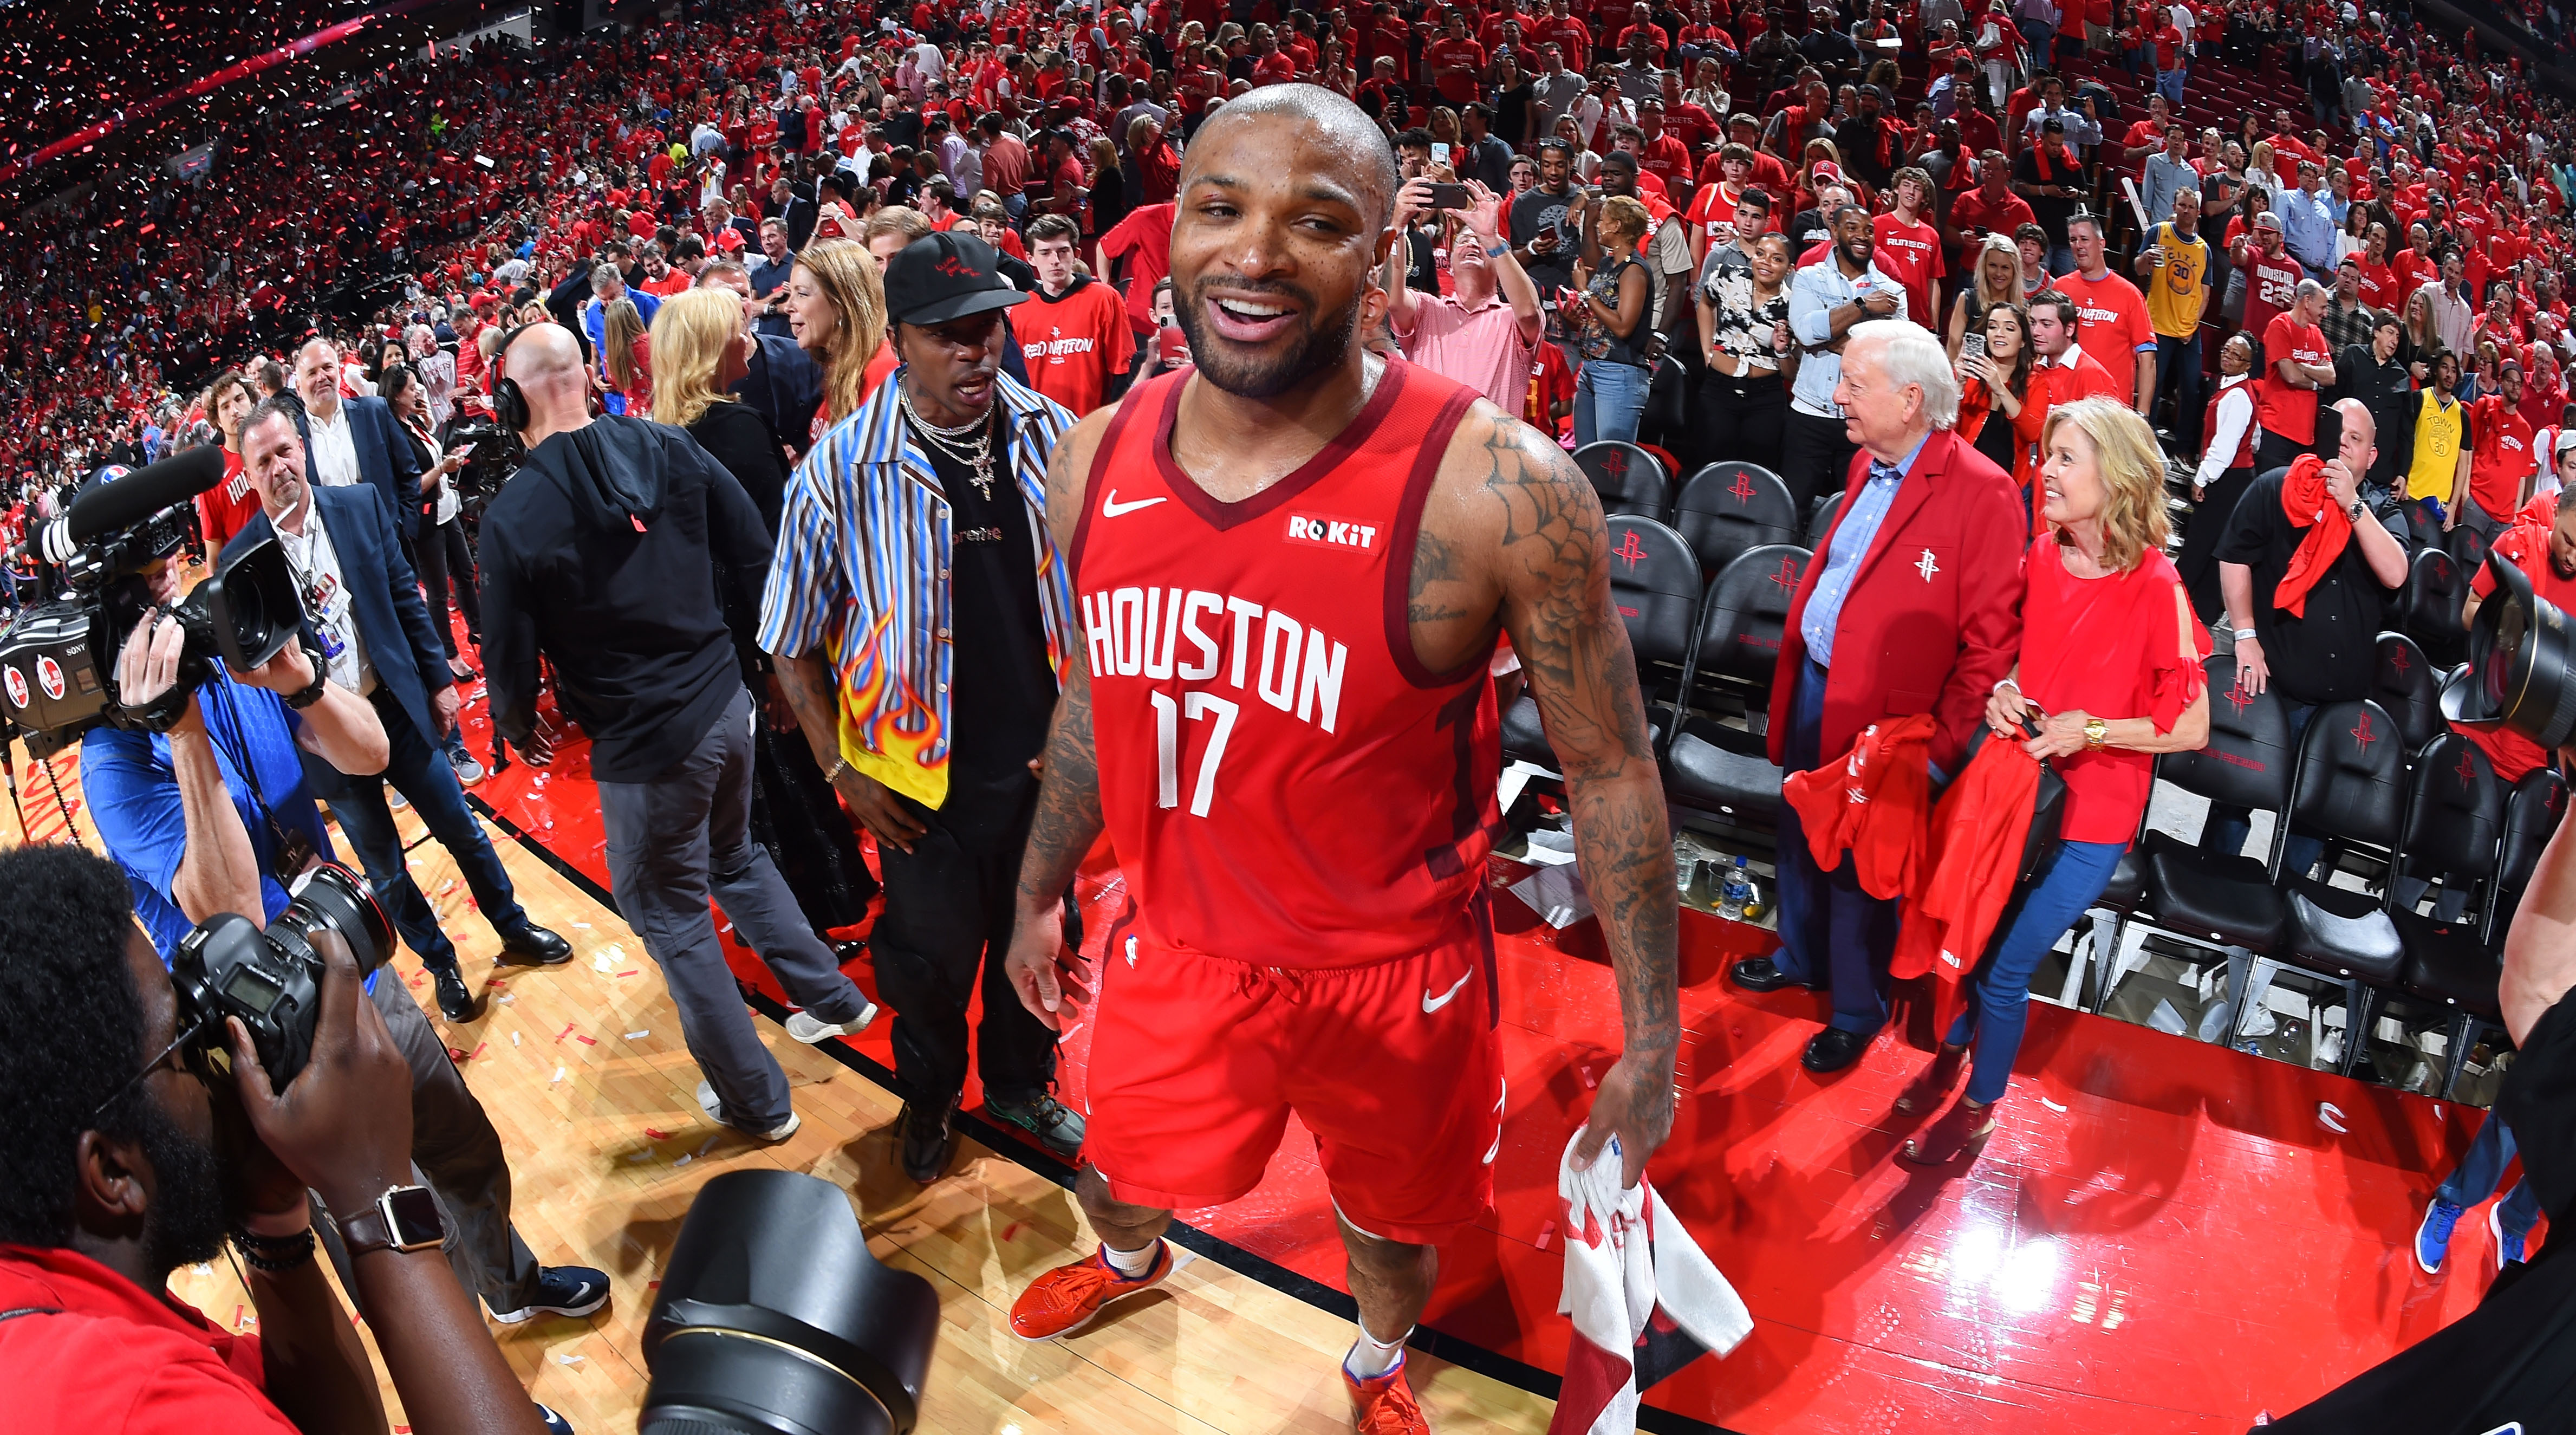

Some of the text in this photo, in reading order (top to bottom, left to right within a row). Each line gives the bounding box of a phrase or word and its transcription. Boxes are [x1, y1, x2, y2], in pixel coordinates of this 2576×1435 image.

[1887, 238, 1909, 246] RUN
[1916, 241, 1933, 252] ONE
[2167, 251, 2197, 268] CITY
[2173, 263, 2190, 280] 30
[2259, 280, 2287, 309] 22
[2081, 308, 2119, 323] NATION
[1022, 337, 1095, 360] RED NATION
[2427, 415, 2455, 433] TOWN
[2434, 441, 2444, 454] 30
[66, 642, 86, 657] SONY
[1082, 586, 1349, 735] HOUSTON
[1149, 689, 1240, 819] 17
[287, 847, 297, 861] TV
